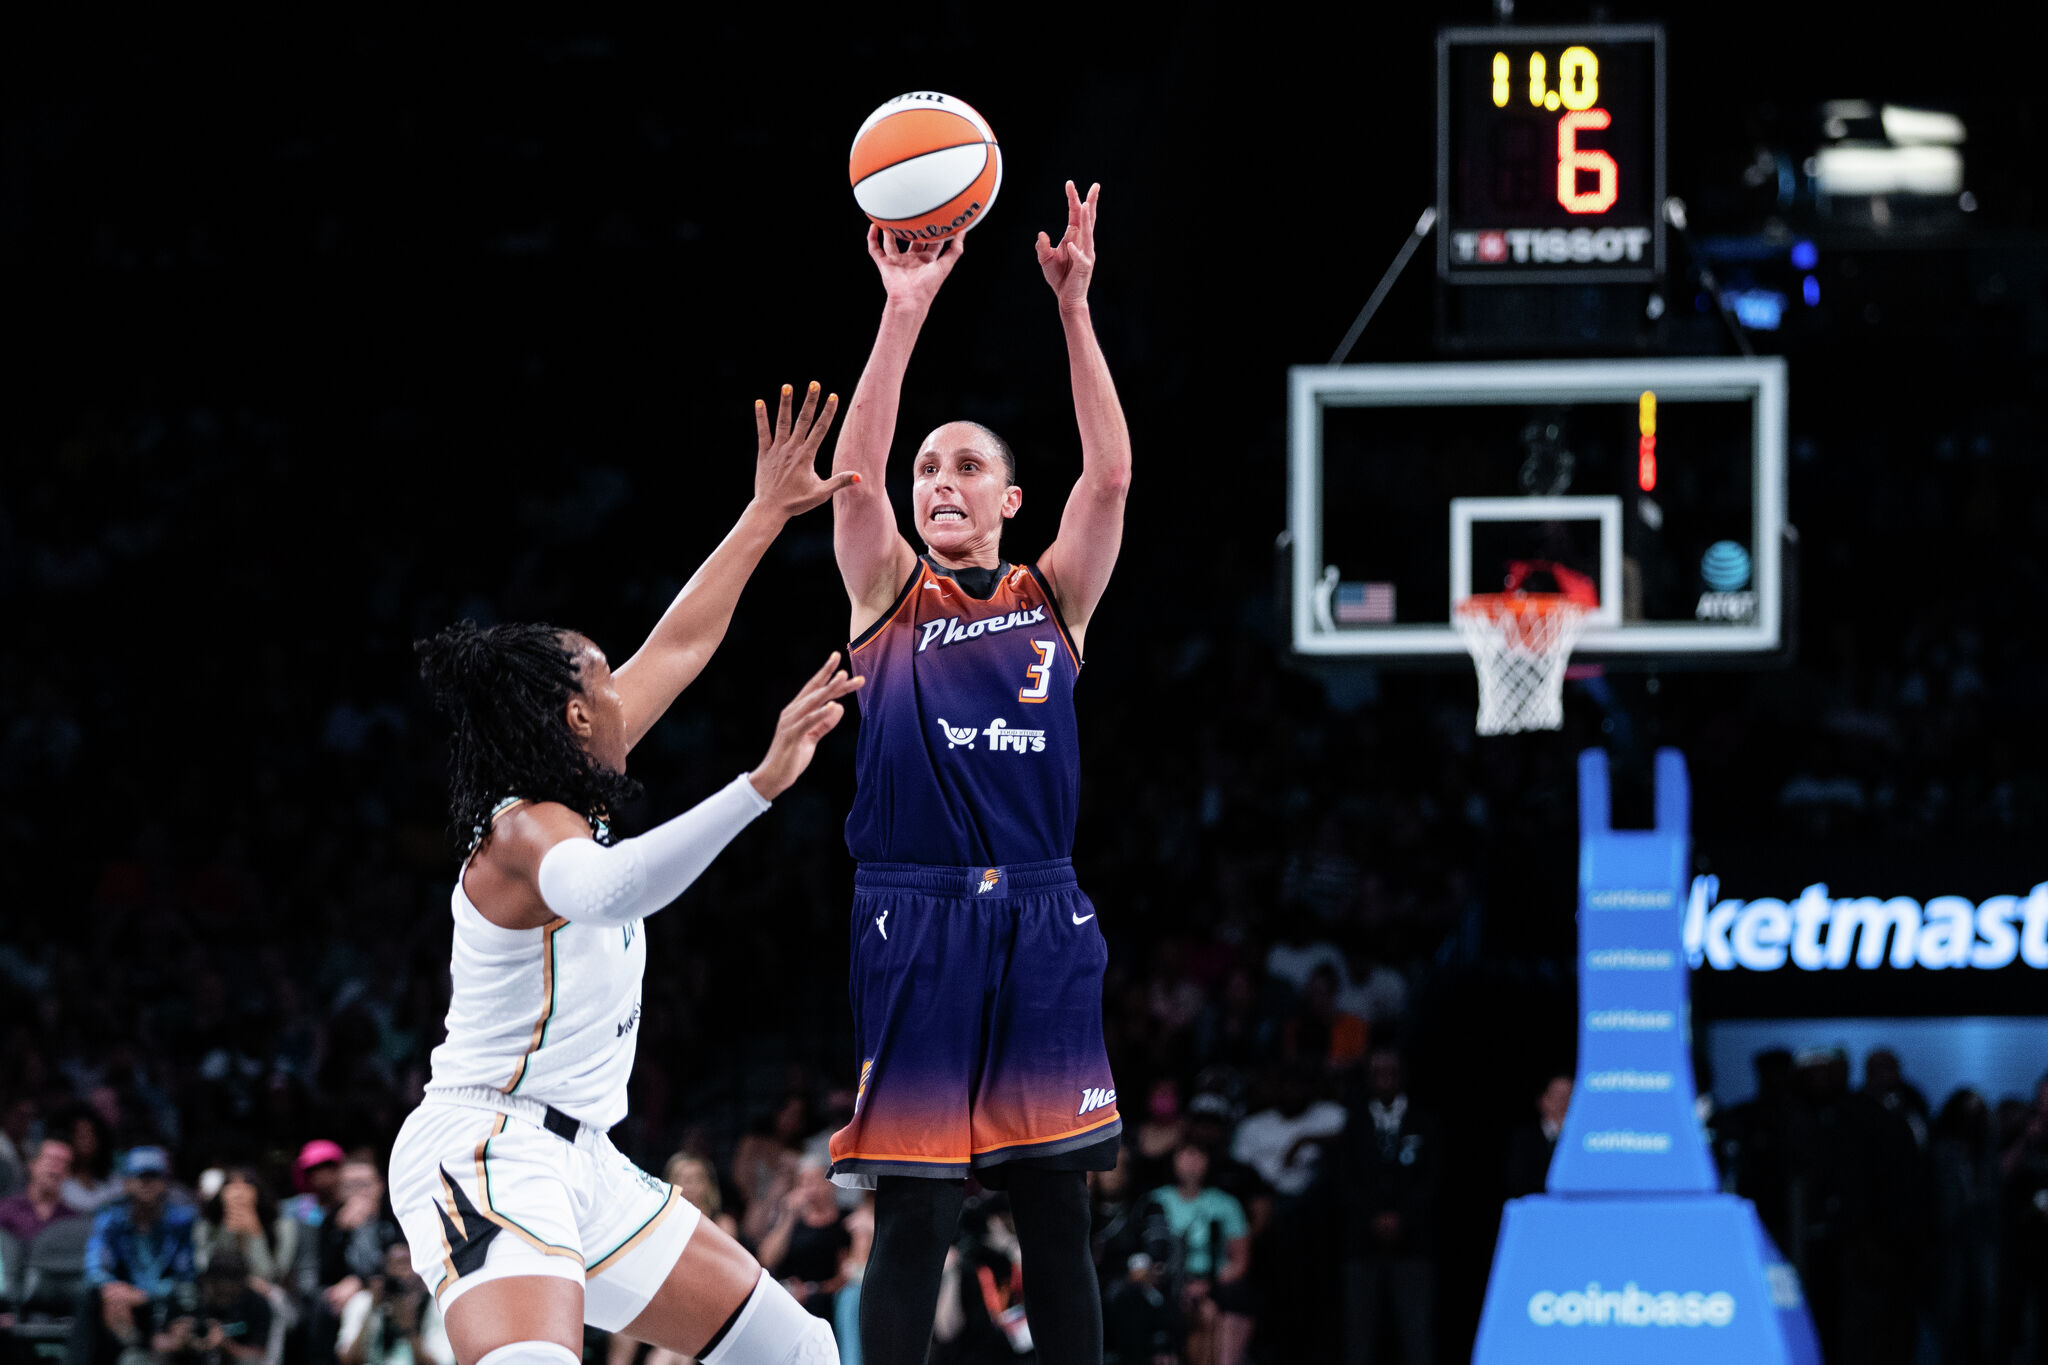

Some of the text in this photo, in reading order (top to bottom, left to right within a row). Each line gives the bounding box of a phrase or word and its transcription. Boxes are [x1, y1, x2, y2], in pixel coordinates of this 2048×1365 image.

[1492, 46, 1599, 111] 11.0
[1557, 108, 1618, 214] 6
[886, 202, 980, 241] Wilson
[916, 600, 1048, 655] Phoenix
[1018, 638, 1056, 704] 3
[982, 717, 1046, 754] fry's
[1078, 1087, 1117, 1116] Me
[1528, 1280, 1736, 1328] coinbase
